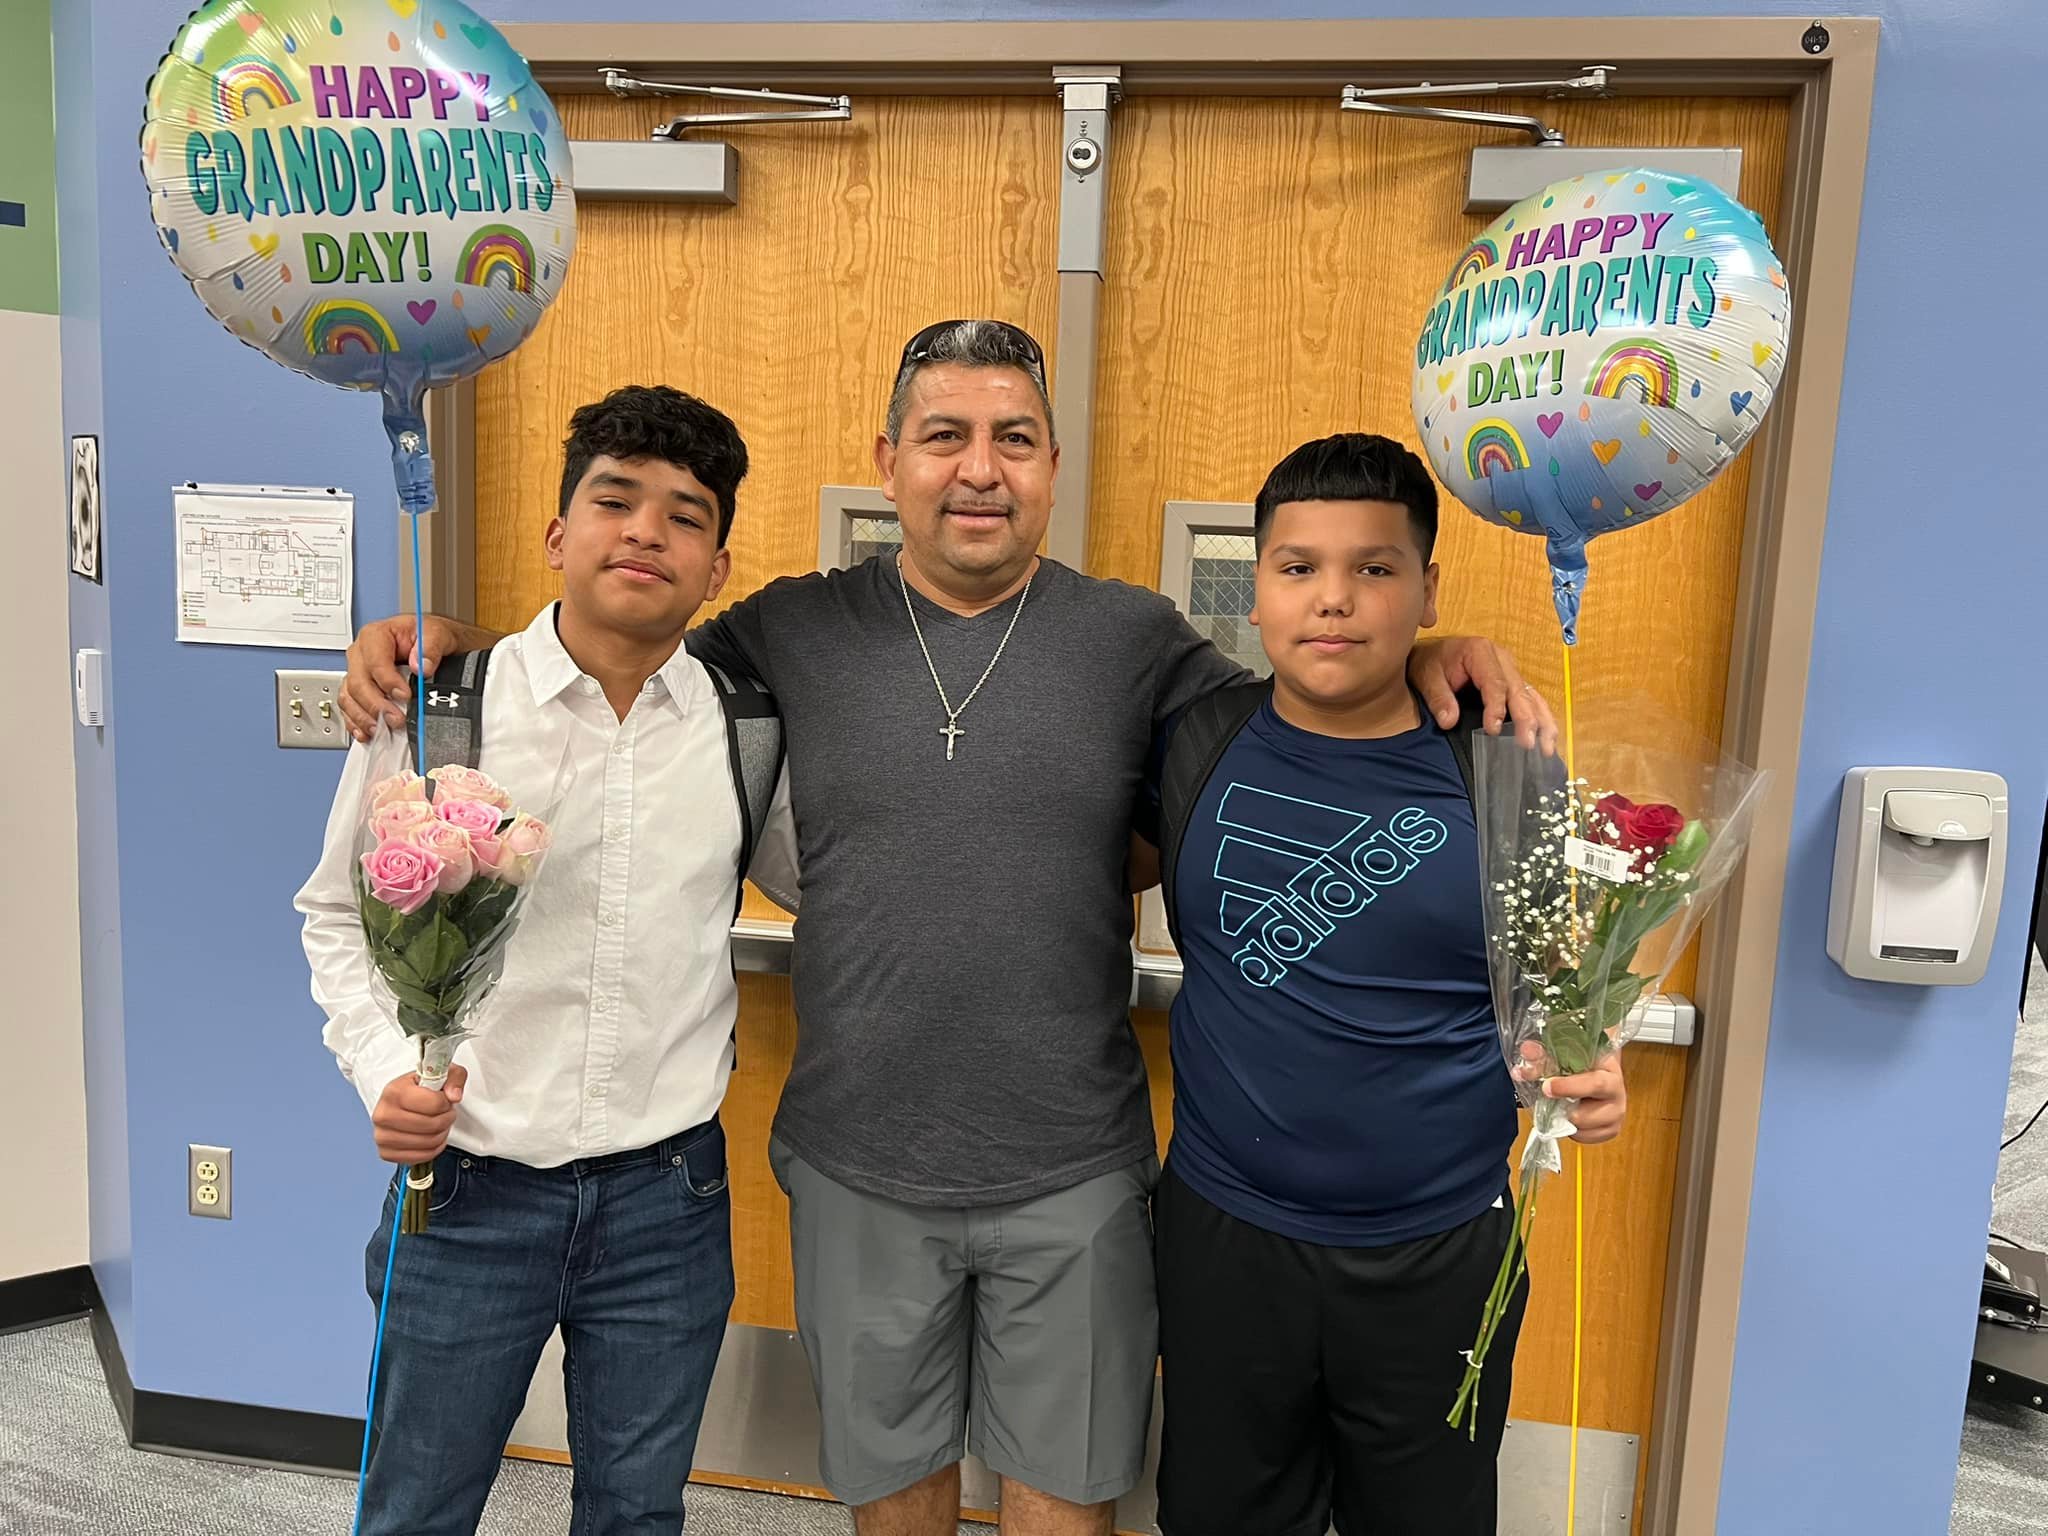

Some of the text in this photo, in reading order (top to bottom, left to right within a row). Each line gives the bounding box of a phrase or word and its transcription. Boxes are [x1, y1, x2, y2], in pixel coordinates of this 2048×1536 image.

[308, 64, 490, 123] HAPPY
[185, 124, 555, 223] GRANDPARENTS
[302, 231, 433, 284] DAY!
[1505, 211, 1674, 271] HAPPY
[1416, 254, 1718, 370] GRANDPARENTS
[1466, 348, 1566, 408] DAY!
[1231, 806, 1448, 988] adidas
